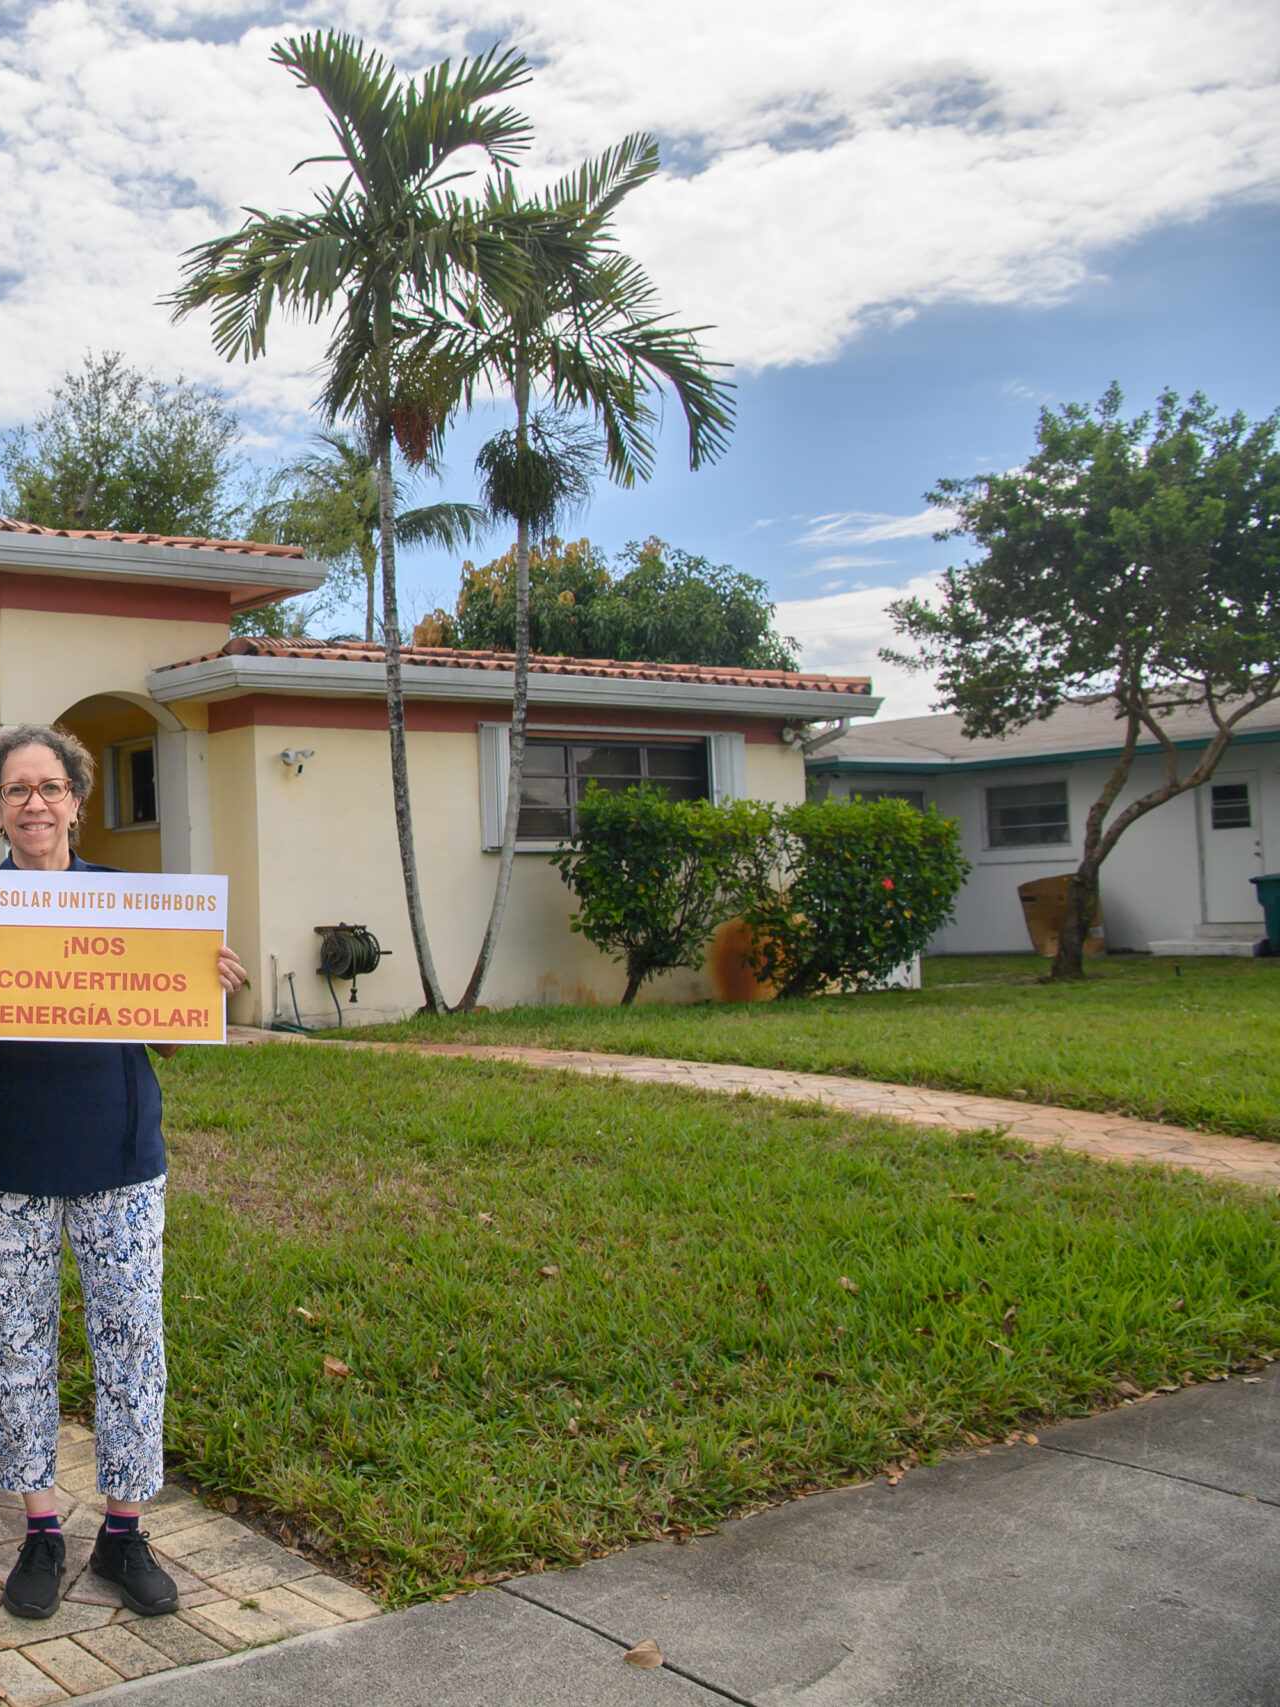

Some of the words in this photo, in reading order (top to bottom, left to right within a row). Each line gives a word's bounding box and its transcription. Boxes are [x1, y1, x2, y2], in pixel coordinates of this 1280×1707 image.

[0, 889, 51, 908] SOLAR
[58, 891, 116, 909] UNITED
[123, 893, 217, 912] NEIGHBORS
[63, 936, 125, 959] ¡NOS
[0, 1003, 112, 1026] ENERGÍA
[117, 1008, 209, 1028] SOLAR!
